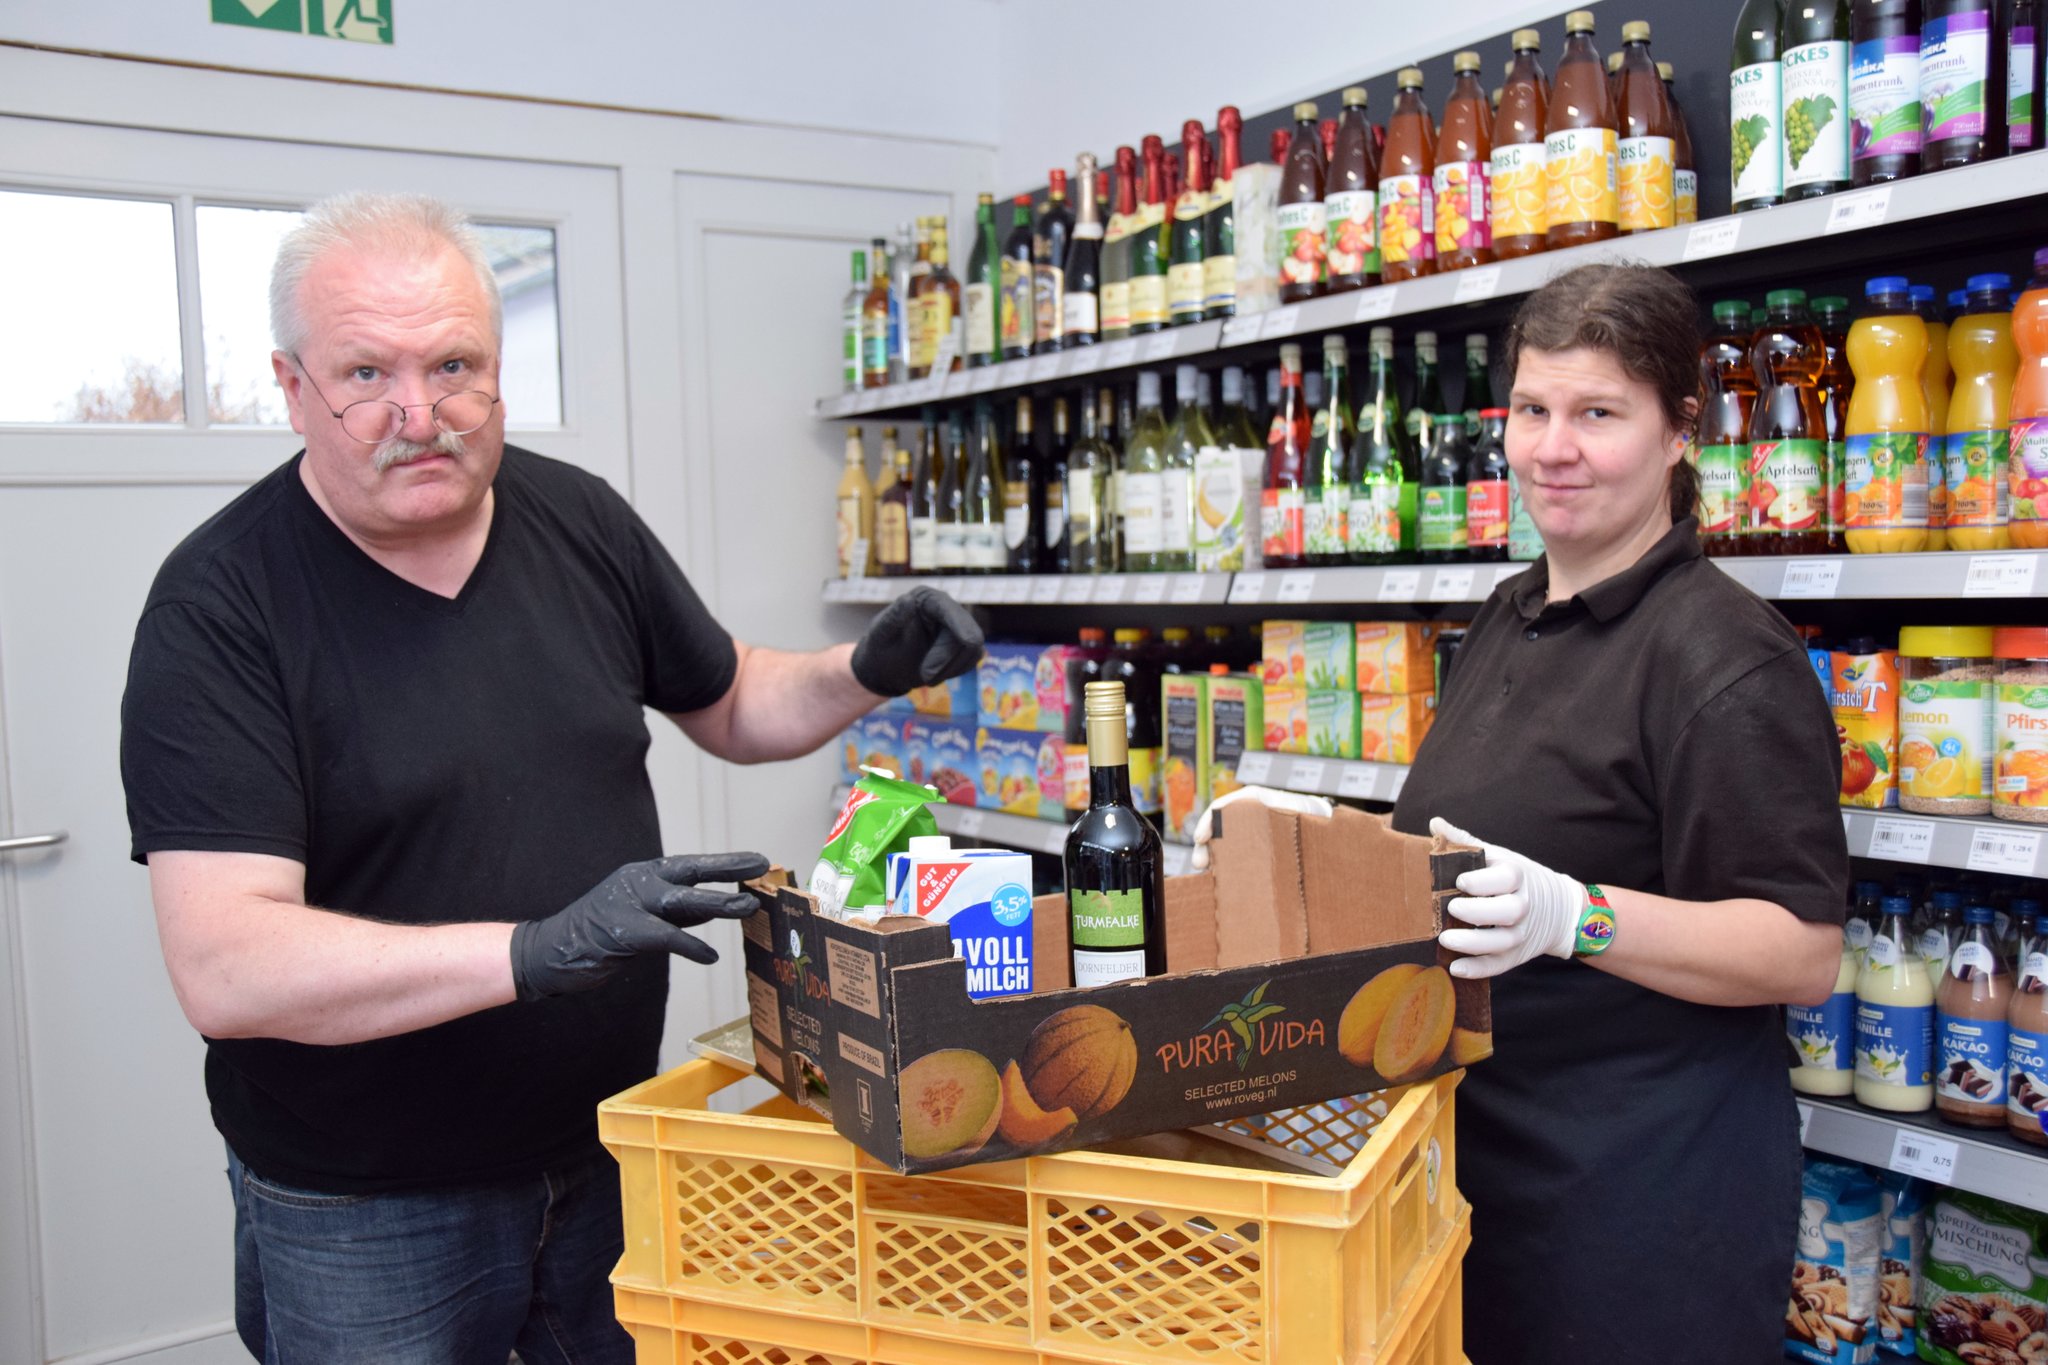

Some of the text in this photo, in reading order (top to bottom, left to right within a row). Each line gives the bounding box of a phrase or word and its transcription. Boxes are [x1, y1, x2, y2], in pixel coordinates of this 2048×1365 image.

[1765, 463, 1818, 479] Apfelsaft
[1862, 680, 1888, 713] T
[919, 866, 938, 888] GUT
[923, 867, 958, 908] GÜNSTIG
[929, 879, 939, 888] &
[994, 895, 1028, 916] 3,5%
[1006, 911, 1021, 922] FETT
[1075, 914, 1140, 930] TURMFALKE
[966, 936, 1029, 967] VOLL
[967, 966, 1029, 993] MILCH
[1155, 1018, 1325, 1074] PURA VIDA
[1943, 1036, 1989, 1054] KAKAO
[1184, 1070, 1297, 1101] SELECTED MELONS
[1205, 1086, 1278, 1110] www.roveg.nl
[1932, 1155, 1952, 1168] 0,75
[1935, 1227, 2024, 1266] MISCHUNG
